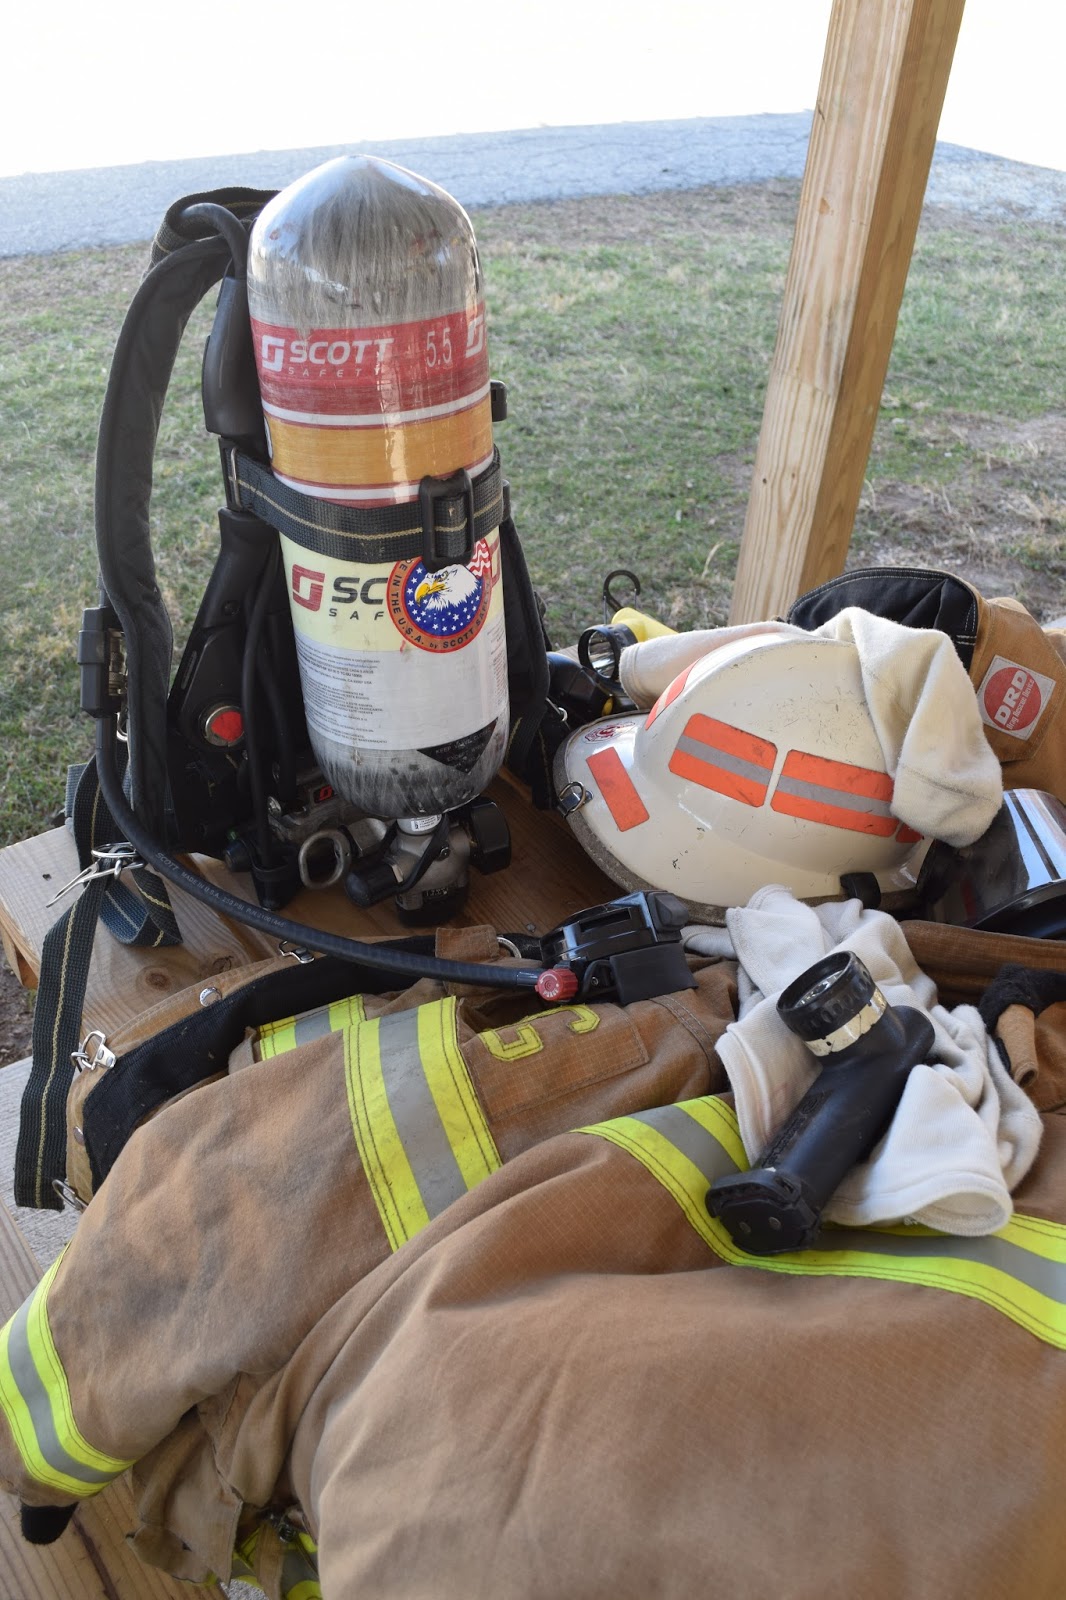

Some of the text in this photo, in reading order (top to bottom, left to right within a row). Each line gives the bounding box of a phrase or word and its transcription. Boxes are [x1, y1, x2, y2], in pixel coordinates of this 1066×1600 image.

[290, 326, 453, 368] SCOTT 5.5
[287, 366, 385, 379] SAFETY
[393, 574, 403, 587] IN
[391, 591, 402, 614] THE
[328, 608, 385, 621] SAF
[429, 642, 439, 650] by
[443, 628, 475, 650] SCOTT
[994, 670, 1027, 725] DRD
[1006, 679, 1035, 730] Drag Rescue Device
[155, 852, 180, 871] SCOTT
[181, 871, 197, 885] MADE
[197, 882, 205, 890] IN
